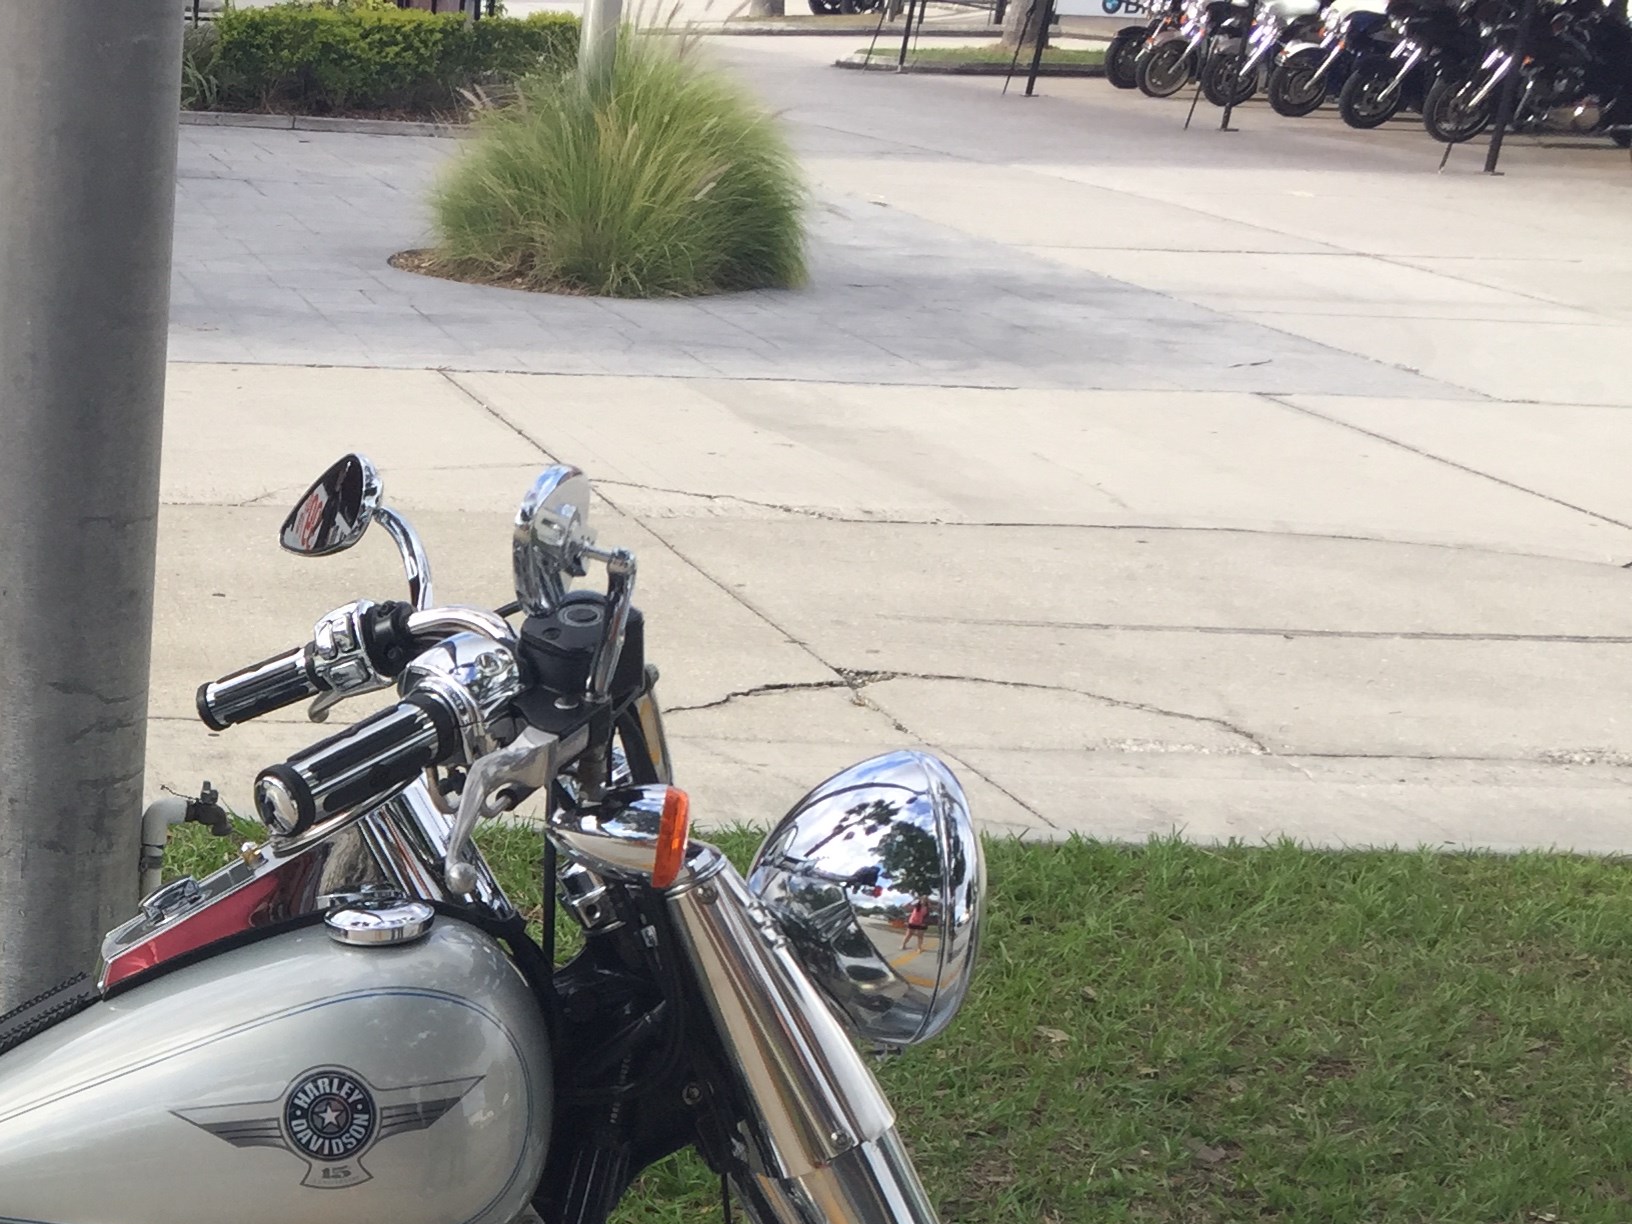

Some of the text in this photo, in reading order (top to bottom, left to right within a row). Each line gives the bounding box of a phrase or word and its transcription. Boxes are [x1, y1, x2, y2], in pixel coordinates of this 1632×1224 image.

[293, 1076, 364, 1108] HARLEY
[290, 1113, 370, 1155] DAVIDSON
[321, 1165, 352, 1179] 15
